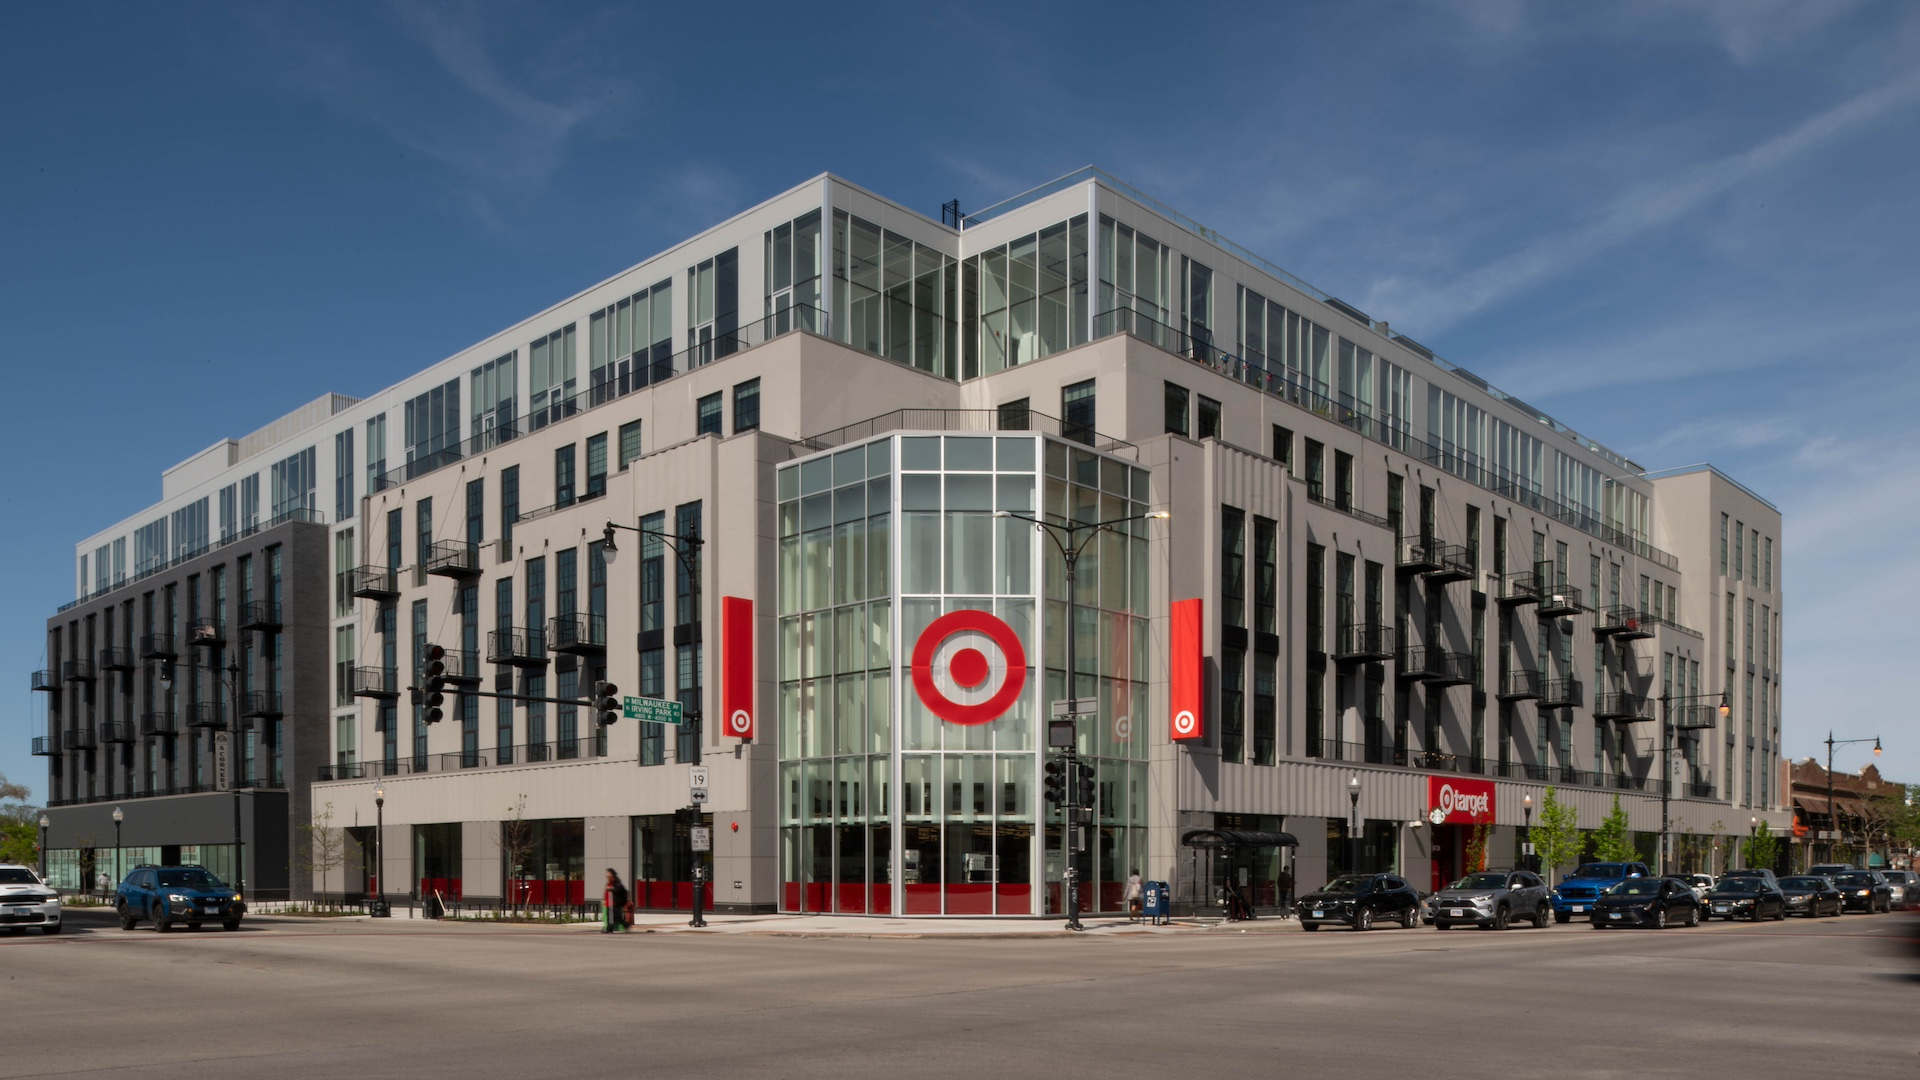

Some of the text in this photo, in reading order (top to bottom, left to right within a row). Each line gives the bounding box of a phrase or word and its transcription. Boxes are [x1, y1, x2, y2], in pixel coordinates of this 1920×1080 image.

[631, 698, 670, 709] MILWAUKEE
[631, 705, 653, 715] IRVING
[655, 708, 672, 717] PARK
[694, 775, 704, 785] 19
[1453, 789, 1489, 817] target
